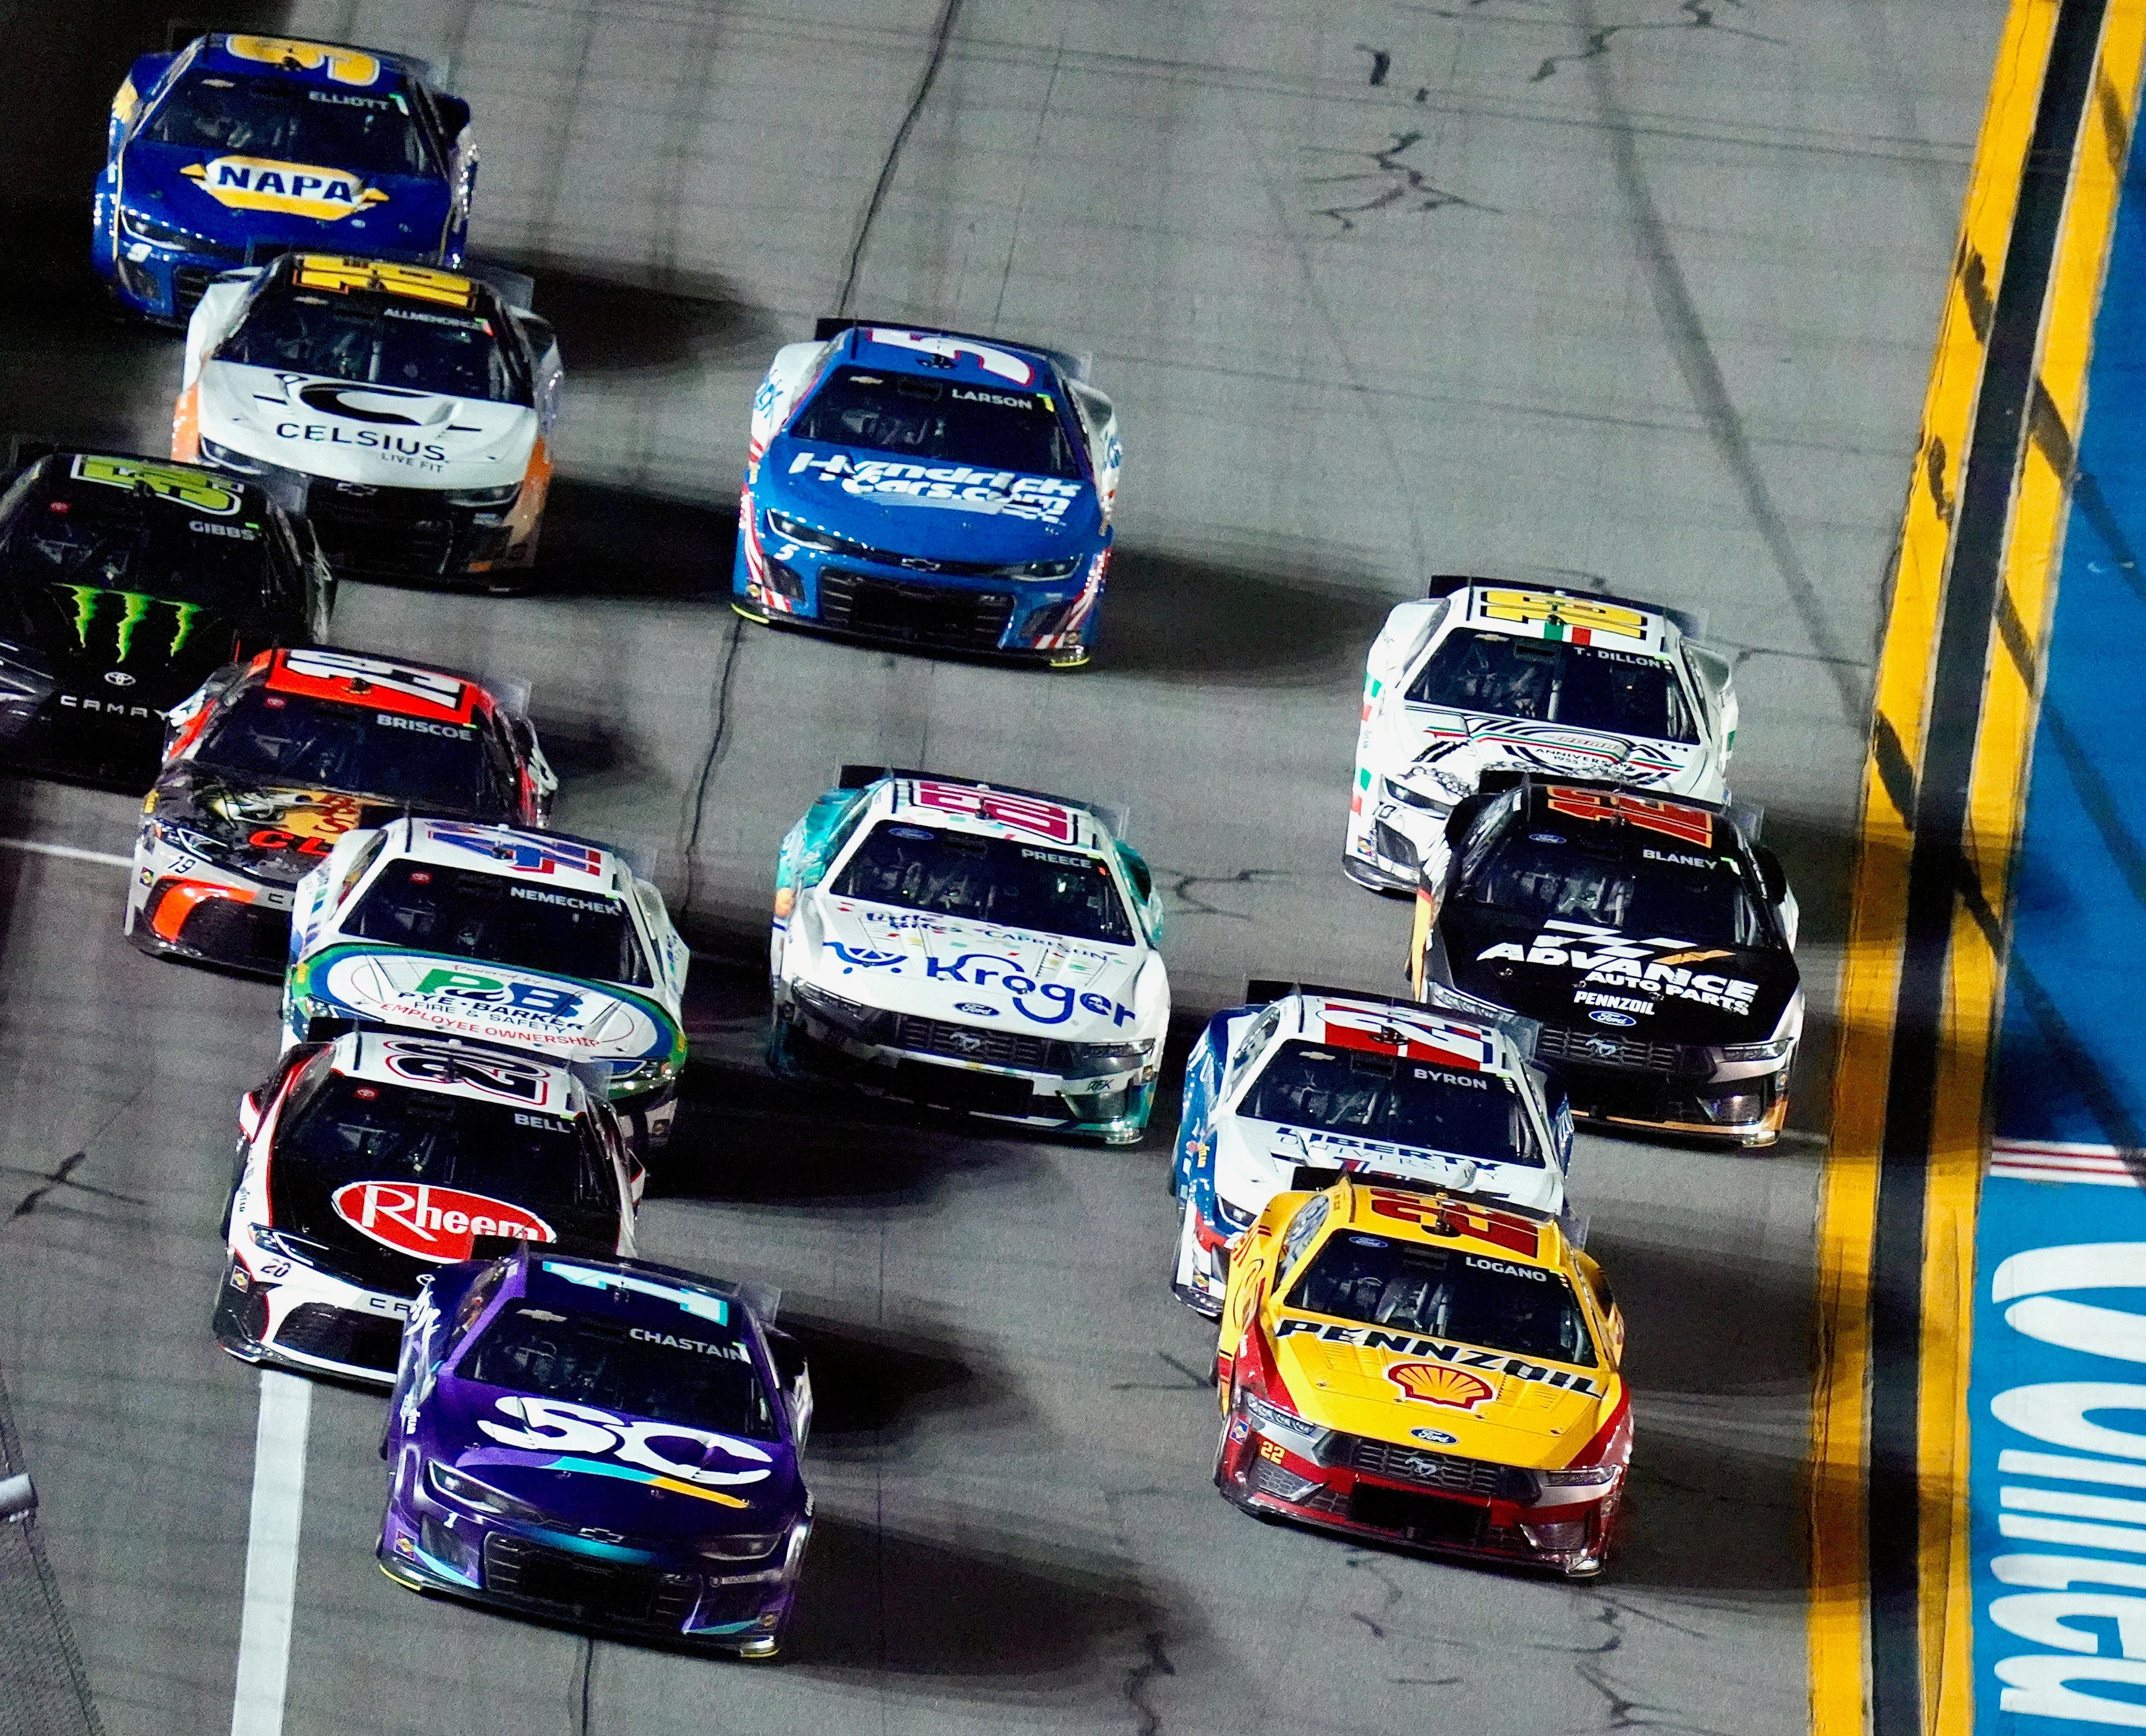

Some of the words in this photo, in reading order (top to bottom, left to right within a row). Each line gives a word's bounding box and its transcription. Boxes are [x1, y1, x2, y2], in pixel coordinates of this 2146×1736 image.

[309, 90, 390, 111] ELLIOTT
[218, 165, 353, 203] NAPA
[953, 389, 1032, 410] LARSON
[276, 423, 446, 461] CELSIUS
[382, 452, 414, 467] LIVE
[419, 461, 444, 473] FIT
[789, 452, 1081, 497] Hendrick
[189, 521, 255, 541] GIBBS
[775, 545, 799, 561] 5
[1574, 646, 1591, 657] T.
[1599, 650, 1661, 669] DILLON
[377, 714, 472, 740] BRISCOE
[167, 854, 197, 873] 19
[1021, 848, 1092, 869] PREECE
[1644, 849, 1717, 870] BLANEY
[511, 886, 618, 915] NEMECHEK
[1477, 936, 1758, 1003] ADVANCE
[926, 954, 1135, 1028] Kroger
[1574, 990, 1654, 1015] PENNZOIL
[1585, 971, 1663, 995] AUTO
[1665, 982, 1749, 1016] PARTS
[415, 1002, 455, 1014] FIRE
[490, 1014, 566, 1034] SAFETY
[957, 1003, 994, 1016] Ford
[1594, 1012, 1630, 1026] Ford
[380, 1004, 479, 1033] EMPLOYEE
[485, 1027, 600, 1047] OWNERSHIP
[1414, 1068, 1487, 1090] BYRON
[514, 1113, 572, 1133] BELL
[1276, 1127, 1501, 1170] LIBERTY
[362, 1185, 538, 1242] Rheem
[261, 1258, 291, 1277] 20
[1466, 1257, 1547, 1282] LOGANO
[630, 1328, 746, 1361] CHASTAIN
[1276, 1319, 1601, 1398] PENNZOIL
[1416, 1429, 1453, 1444] Ford
[1260, 1441, 1285, 1464] 22
[444, 1512, 459, 1529] 1
